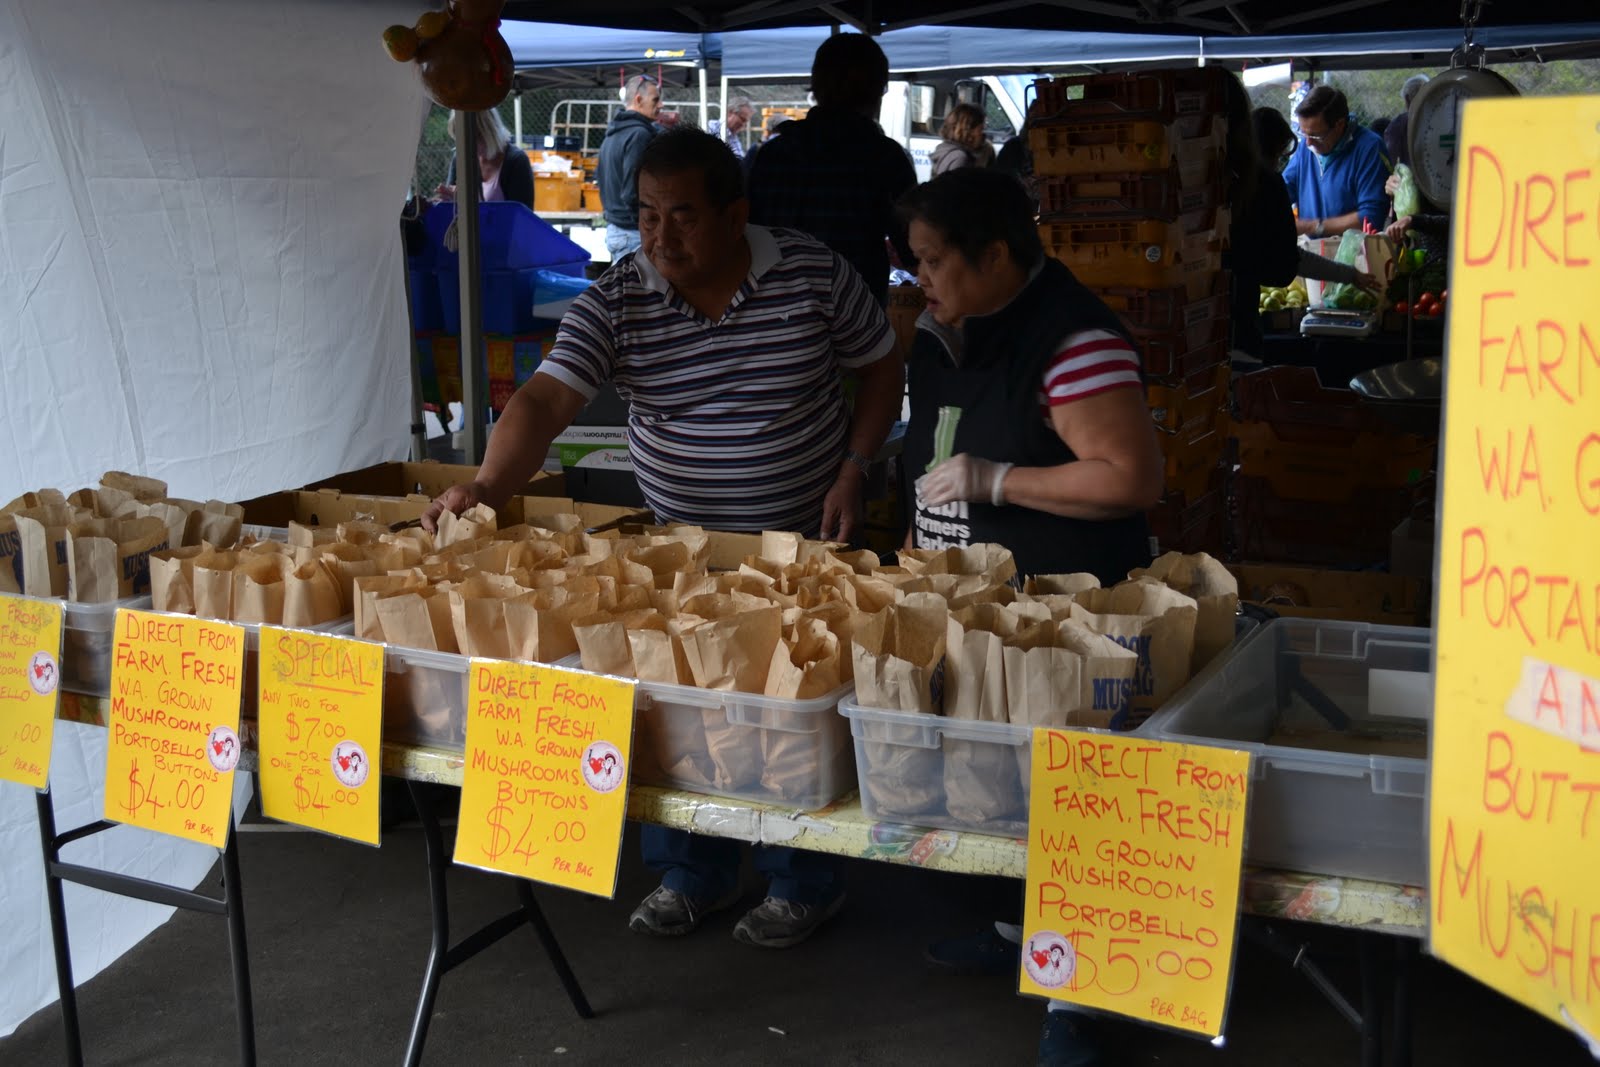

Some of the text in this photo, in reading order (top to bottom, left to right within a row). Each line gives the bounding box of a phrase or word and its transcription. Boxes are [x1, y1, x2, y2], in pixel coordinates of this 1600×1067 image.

[1464, 146, 1600, 272] DIRE
[915, 509, 971, 539] Farmers
[7, 604, 42, 627] FROM
[126, 613, 237, 656] DIRECT FROM
[0, 624, 37, 649] FRESH
[182, 652, 236, 690] FRESH
[278, 635, 375, 687] SPECIAL
[158, 681, 212, 712] GROWN
[262, 688, 341, 713] ANY TWO FOR
[478, 667, 606, 712] DIRECT FROM
[112, 697, 211, 737] MUSHROOMS
[285, 711, 346, 749] $7.00
[478, 700, 595, 740] FARM FRESH
[115, 723, 205, 760] PORTOBELLO
[535, 737, 583, 760] GROWN
[154, 754, 219, 783] BUTTONS
[270, 756, 323, 777] ONE FOR
[1046, 731, 1245, 794] DIRECT FROM
[120, 757, 205, 819] $4.00
[293, 773, 359, 820] $4.00
[497, 780, 589, 811] BUTTONS
[184, 819, 214, 839] PER BAG
[481, 801, 586, 866] $4.00
[1136, 788, 1231, 848] FRESH
[553, 857, 593, 878] PER BAG
[1096, 840, 1196, 872] GROWN
[1050, 857, 1215, 910] MUSHROOMS
[1039, 881, 1219, 948] PORTOBELLO
[1150, 997, 1208, 1029] PER BAG
